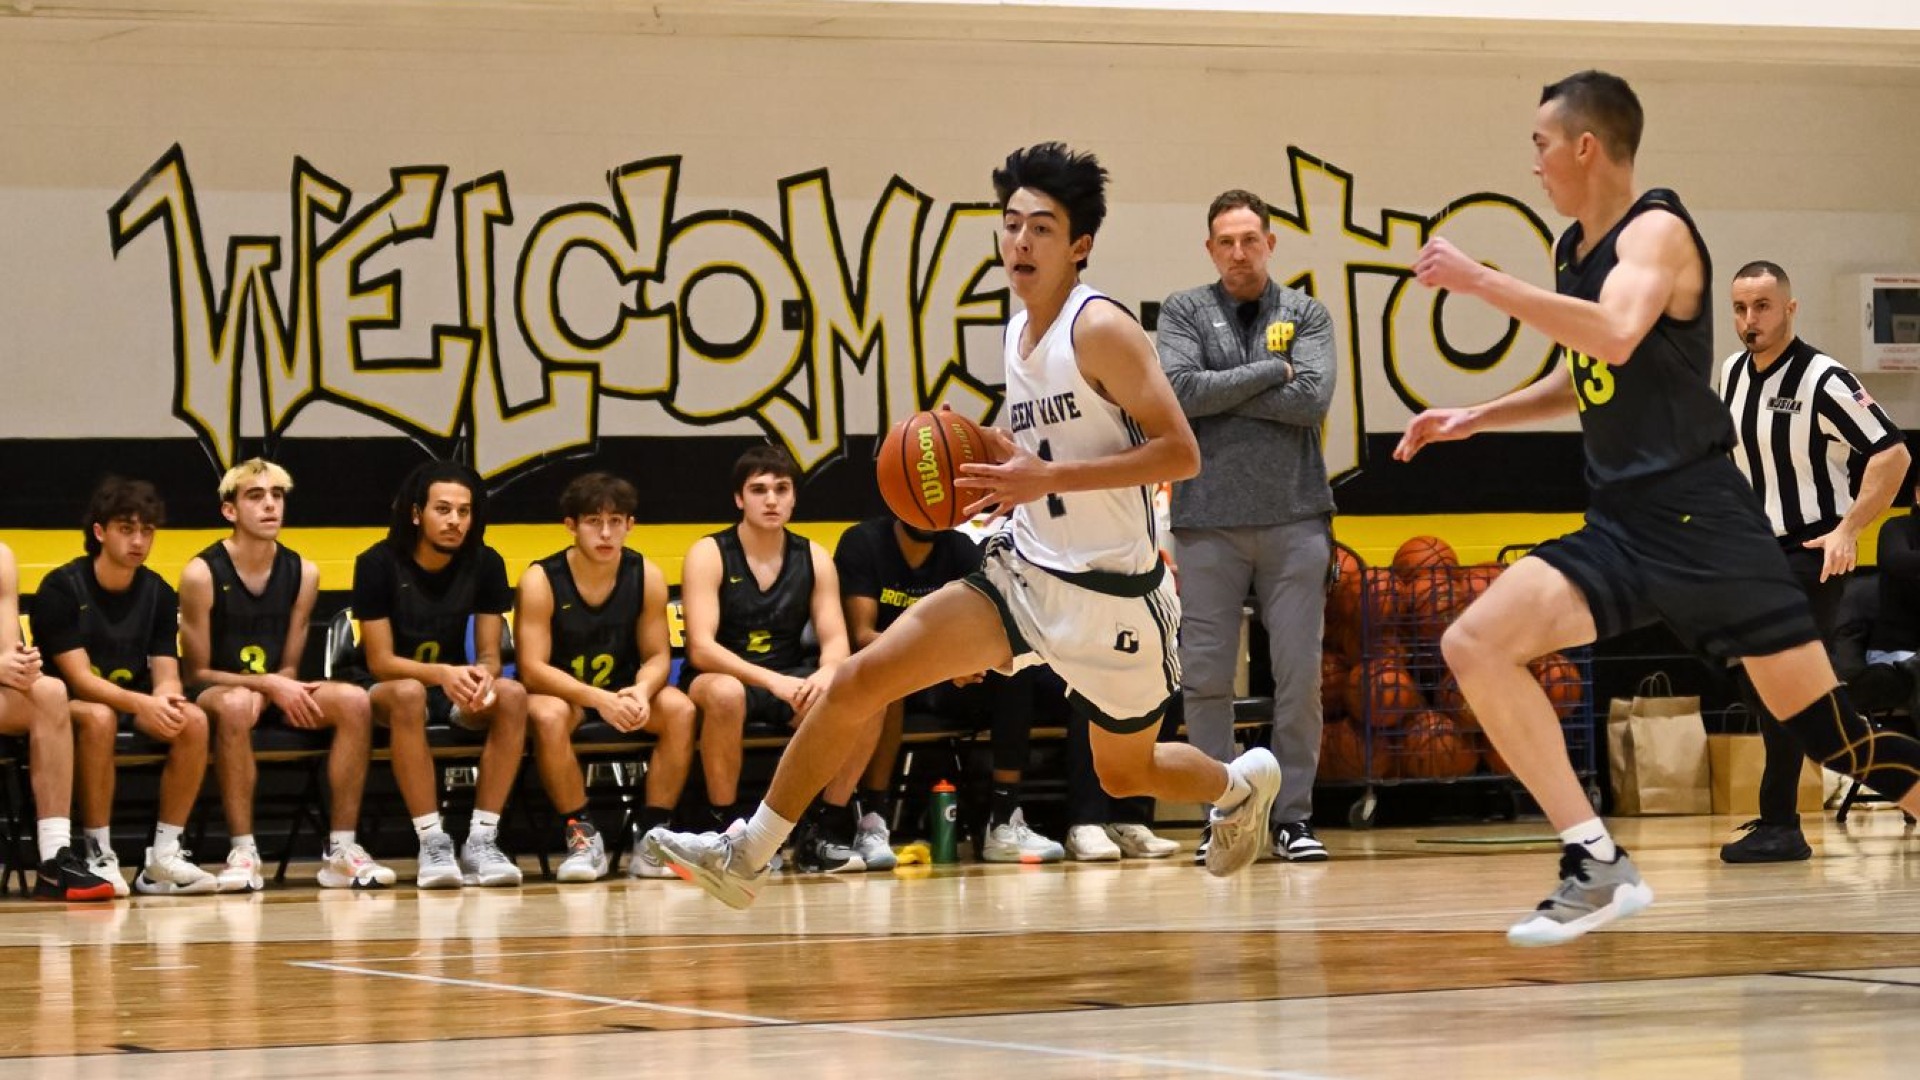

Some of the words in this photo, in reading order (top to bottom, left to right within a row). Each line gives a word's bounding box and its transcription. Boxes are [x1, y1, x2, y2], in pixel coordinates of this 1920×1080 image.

[107, 141, 1010, 484] WELCOME
[1036, 390, 1082, 425] WAVE
[916, 425, 945, 506] Wilson
[240, 645, 266, 674] 3
[570, 653, 615, 688] 12
